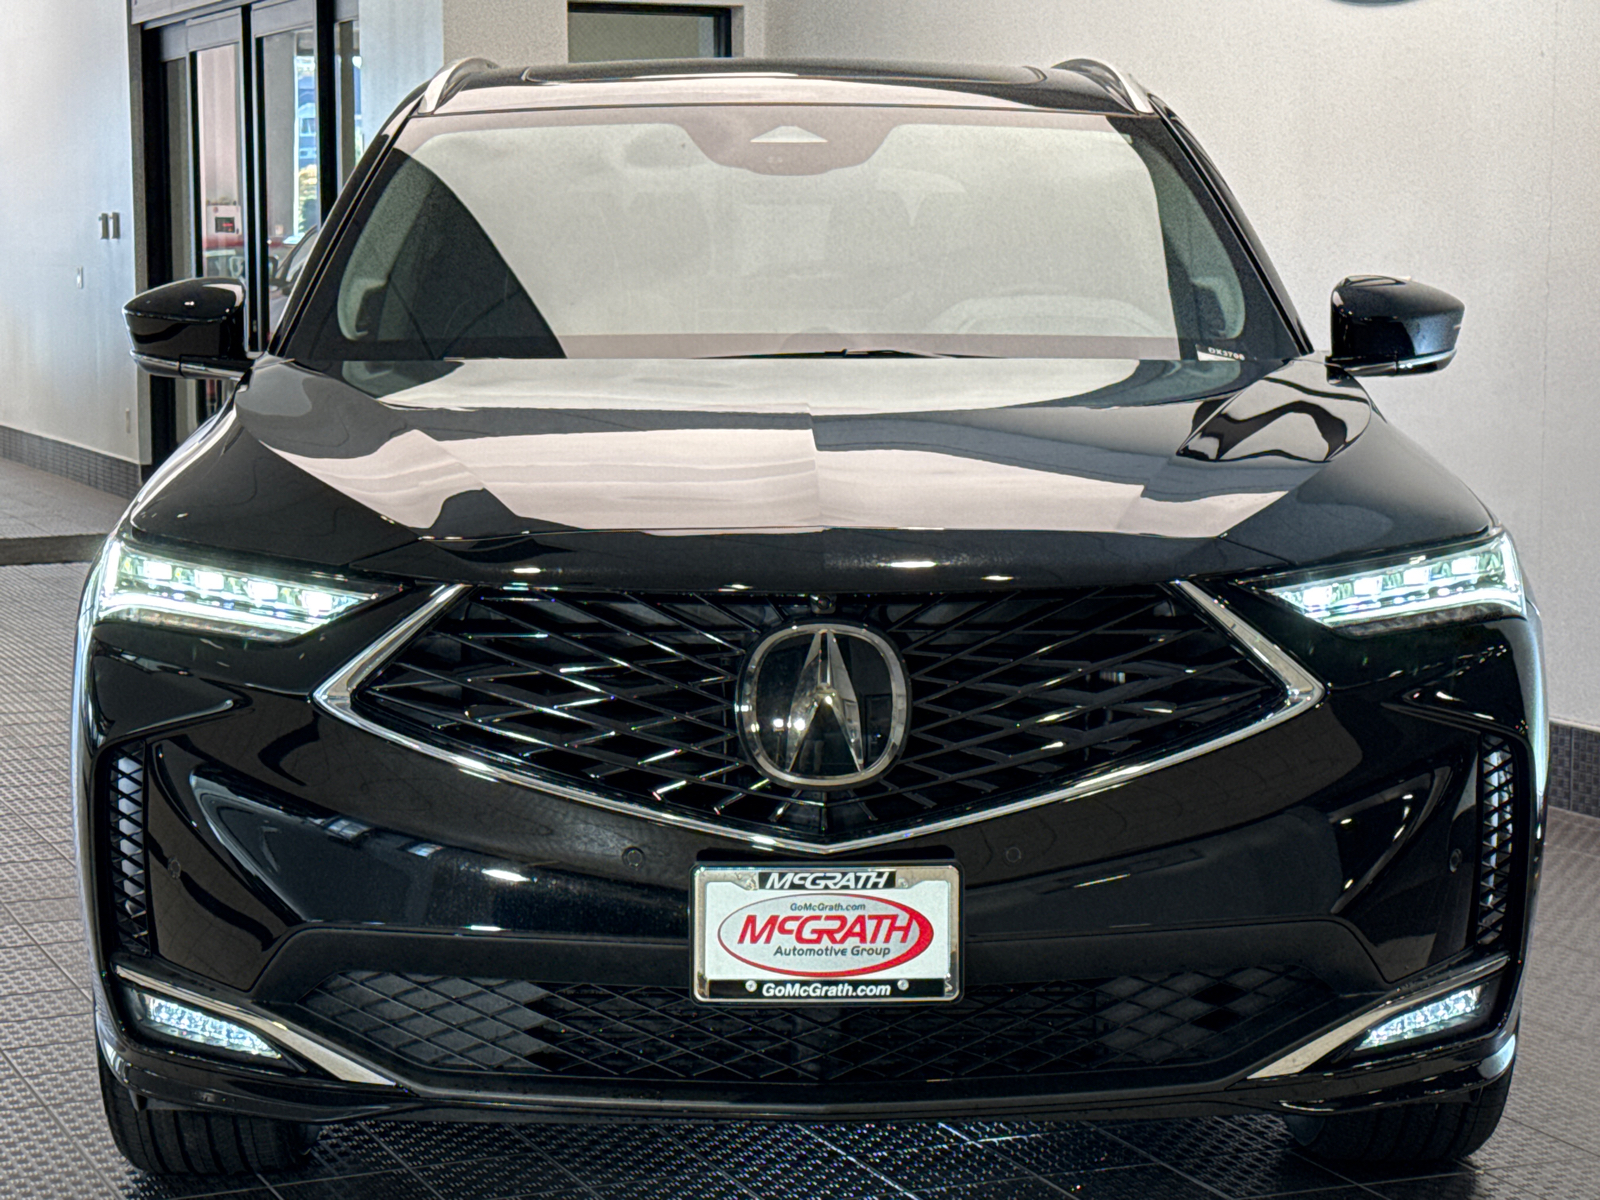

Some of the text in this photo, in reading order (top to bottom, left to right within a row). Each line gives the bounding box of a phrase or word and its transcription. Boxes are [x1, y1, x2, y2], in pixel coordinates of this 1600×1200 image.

[790, 903, 865, 912] GoMcGrath.com
[773, 945, 891, 959] Automotive Group
[762, 983, 891, 997] GoMcGrath.com
